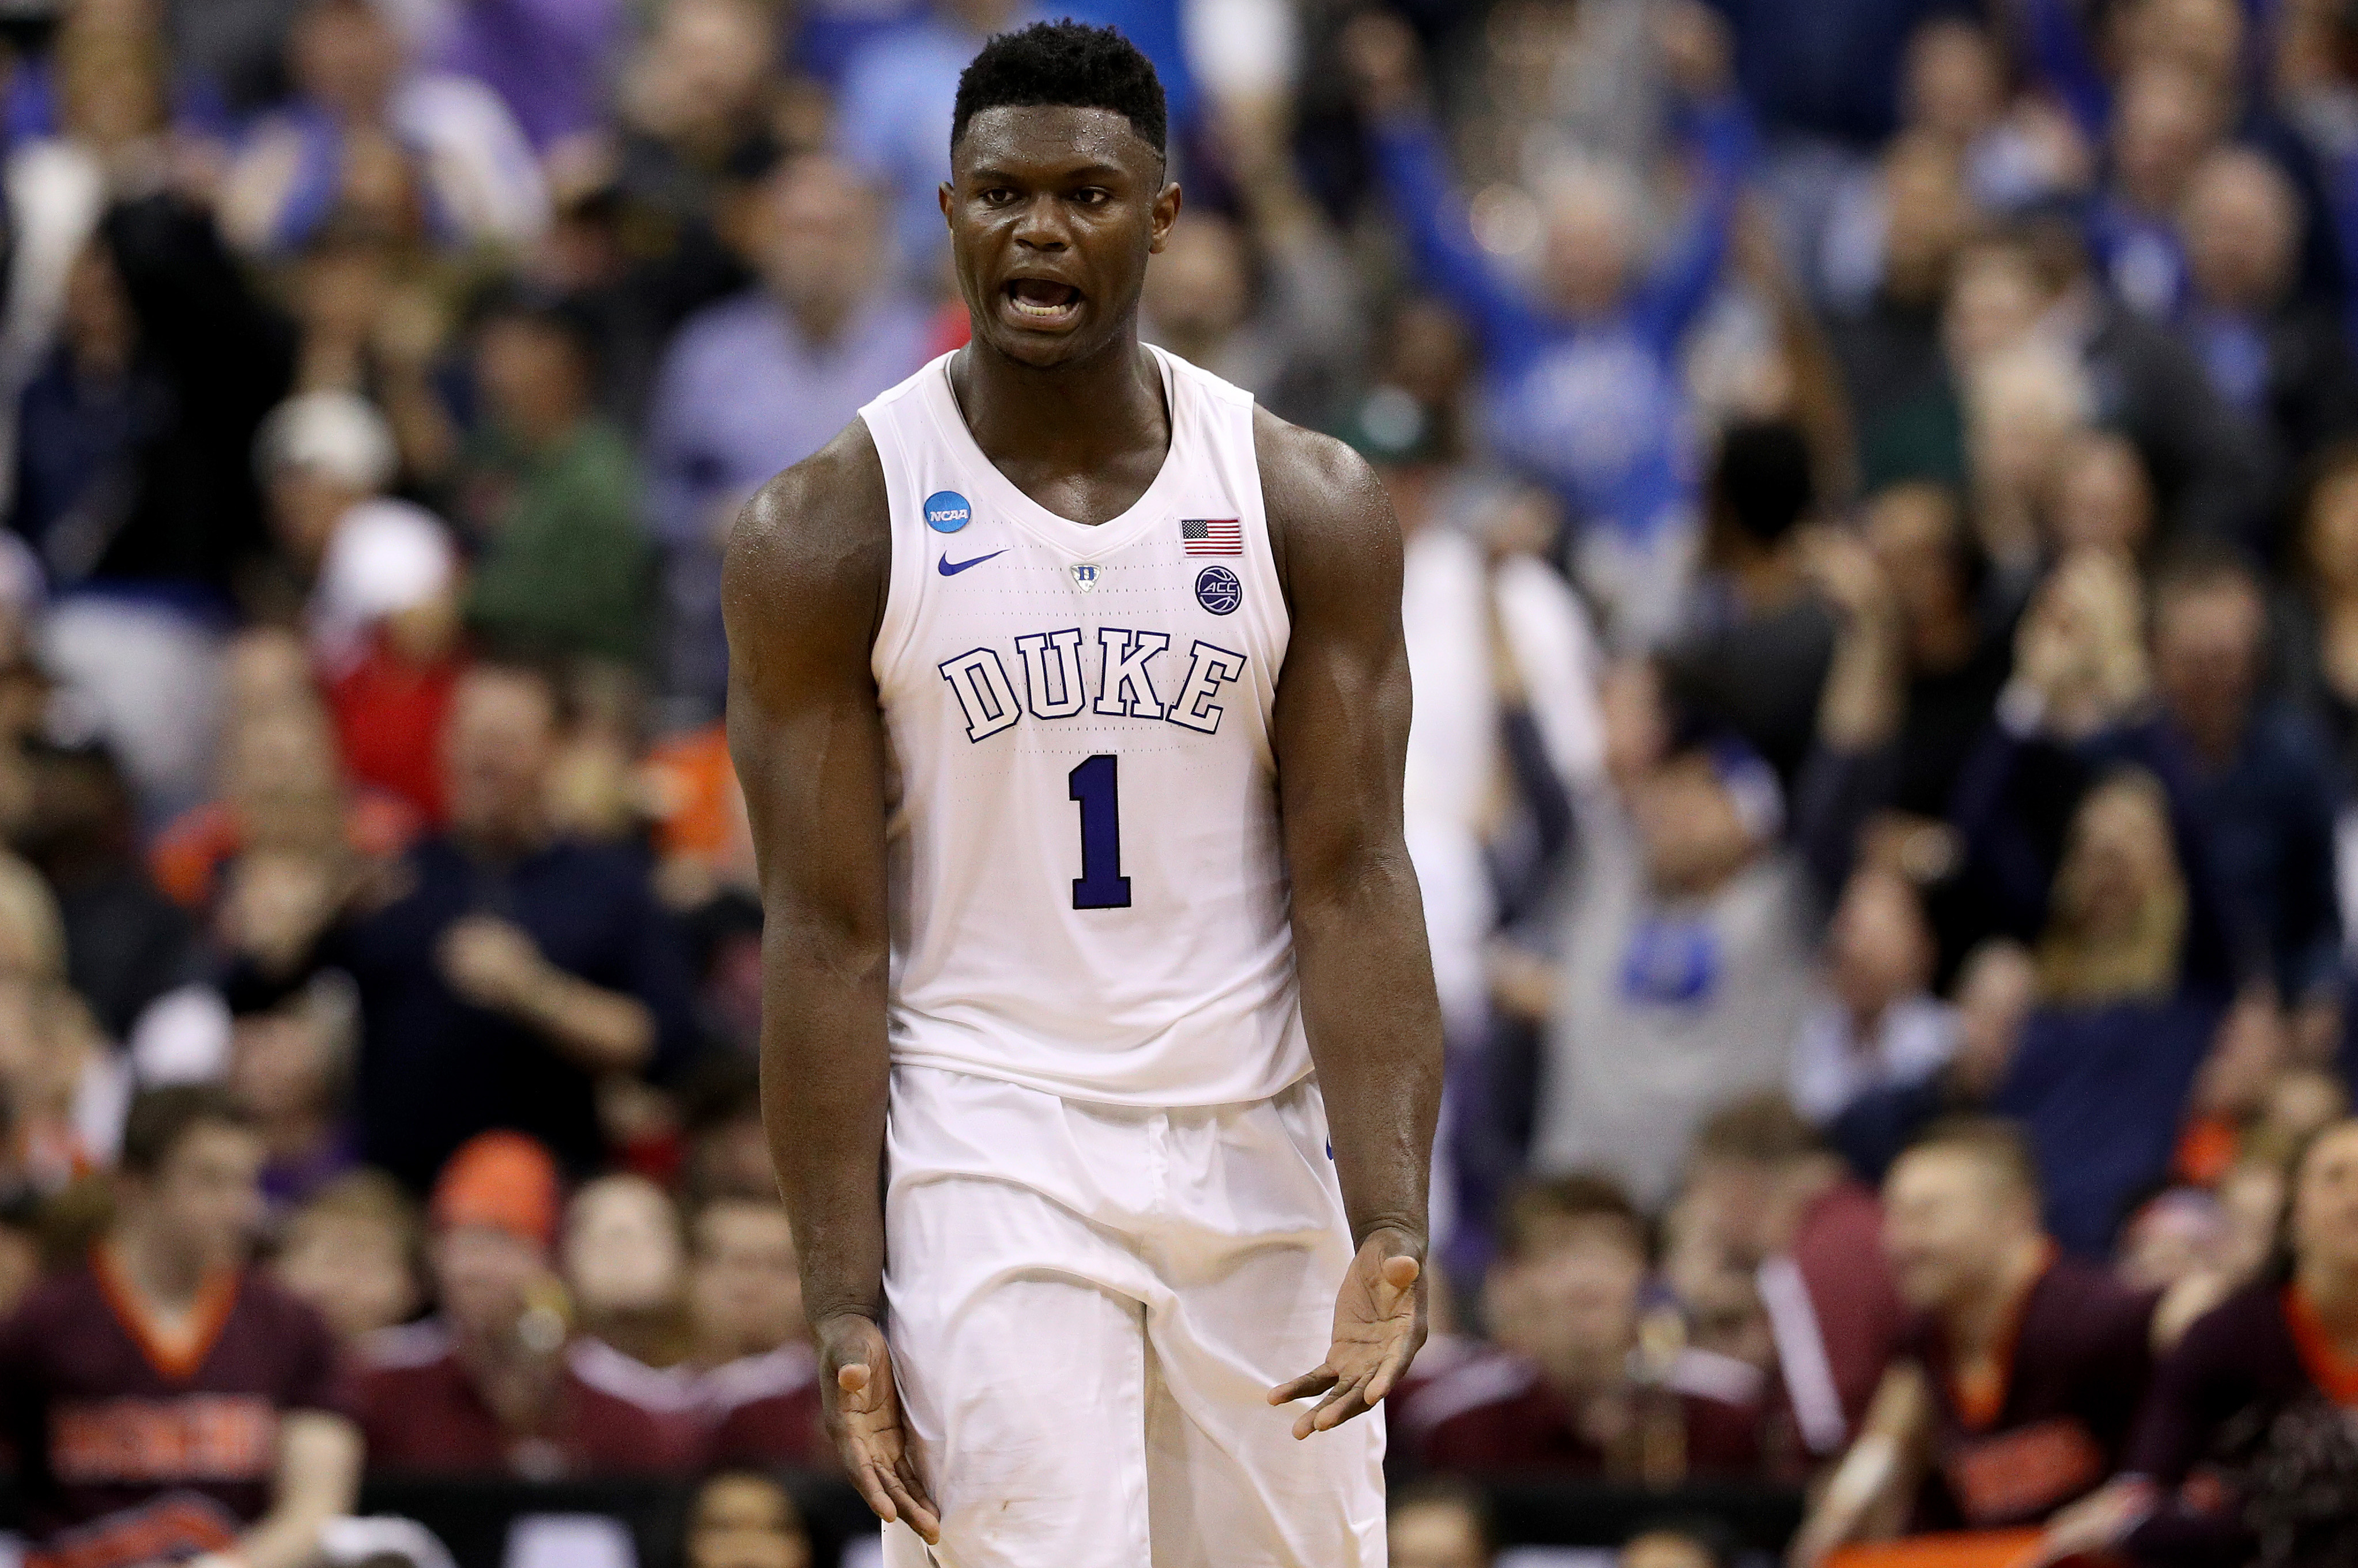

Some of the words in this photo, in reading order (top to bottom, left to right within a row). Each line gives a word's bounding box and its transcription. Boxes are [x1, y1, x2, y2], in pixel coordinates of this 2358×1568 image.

[930, 509, 968, 522] NCAA
[1202, 582, 1238, 592] ACC
[938, 627, 1247, 744] DUKE
[1069, 754, 1131, 909] 1
